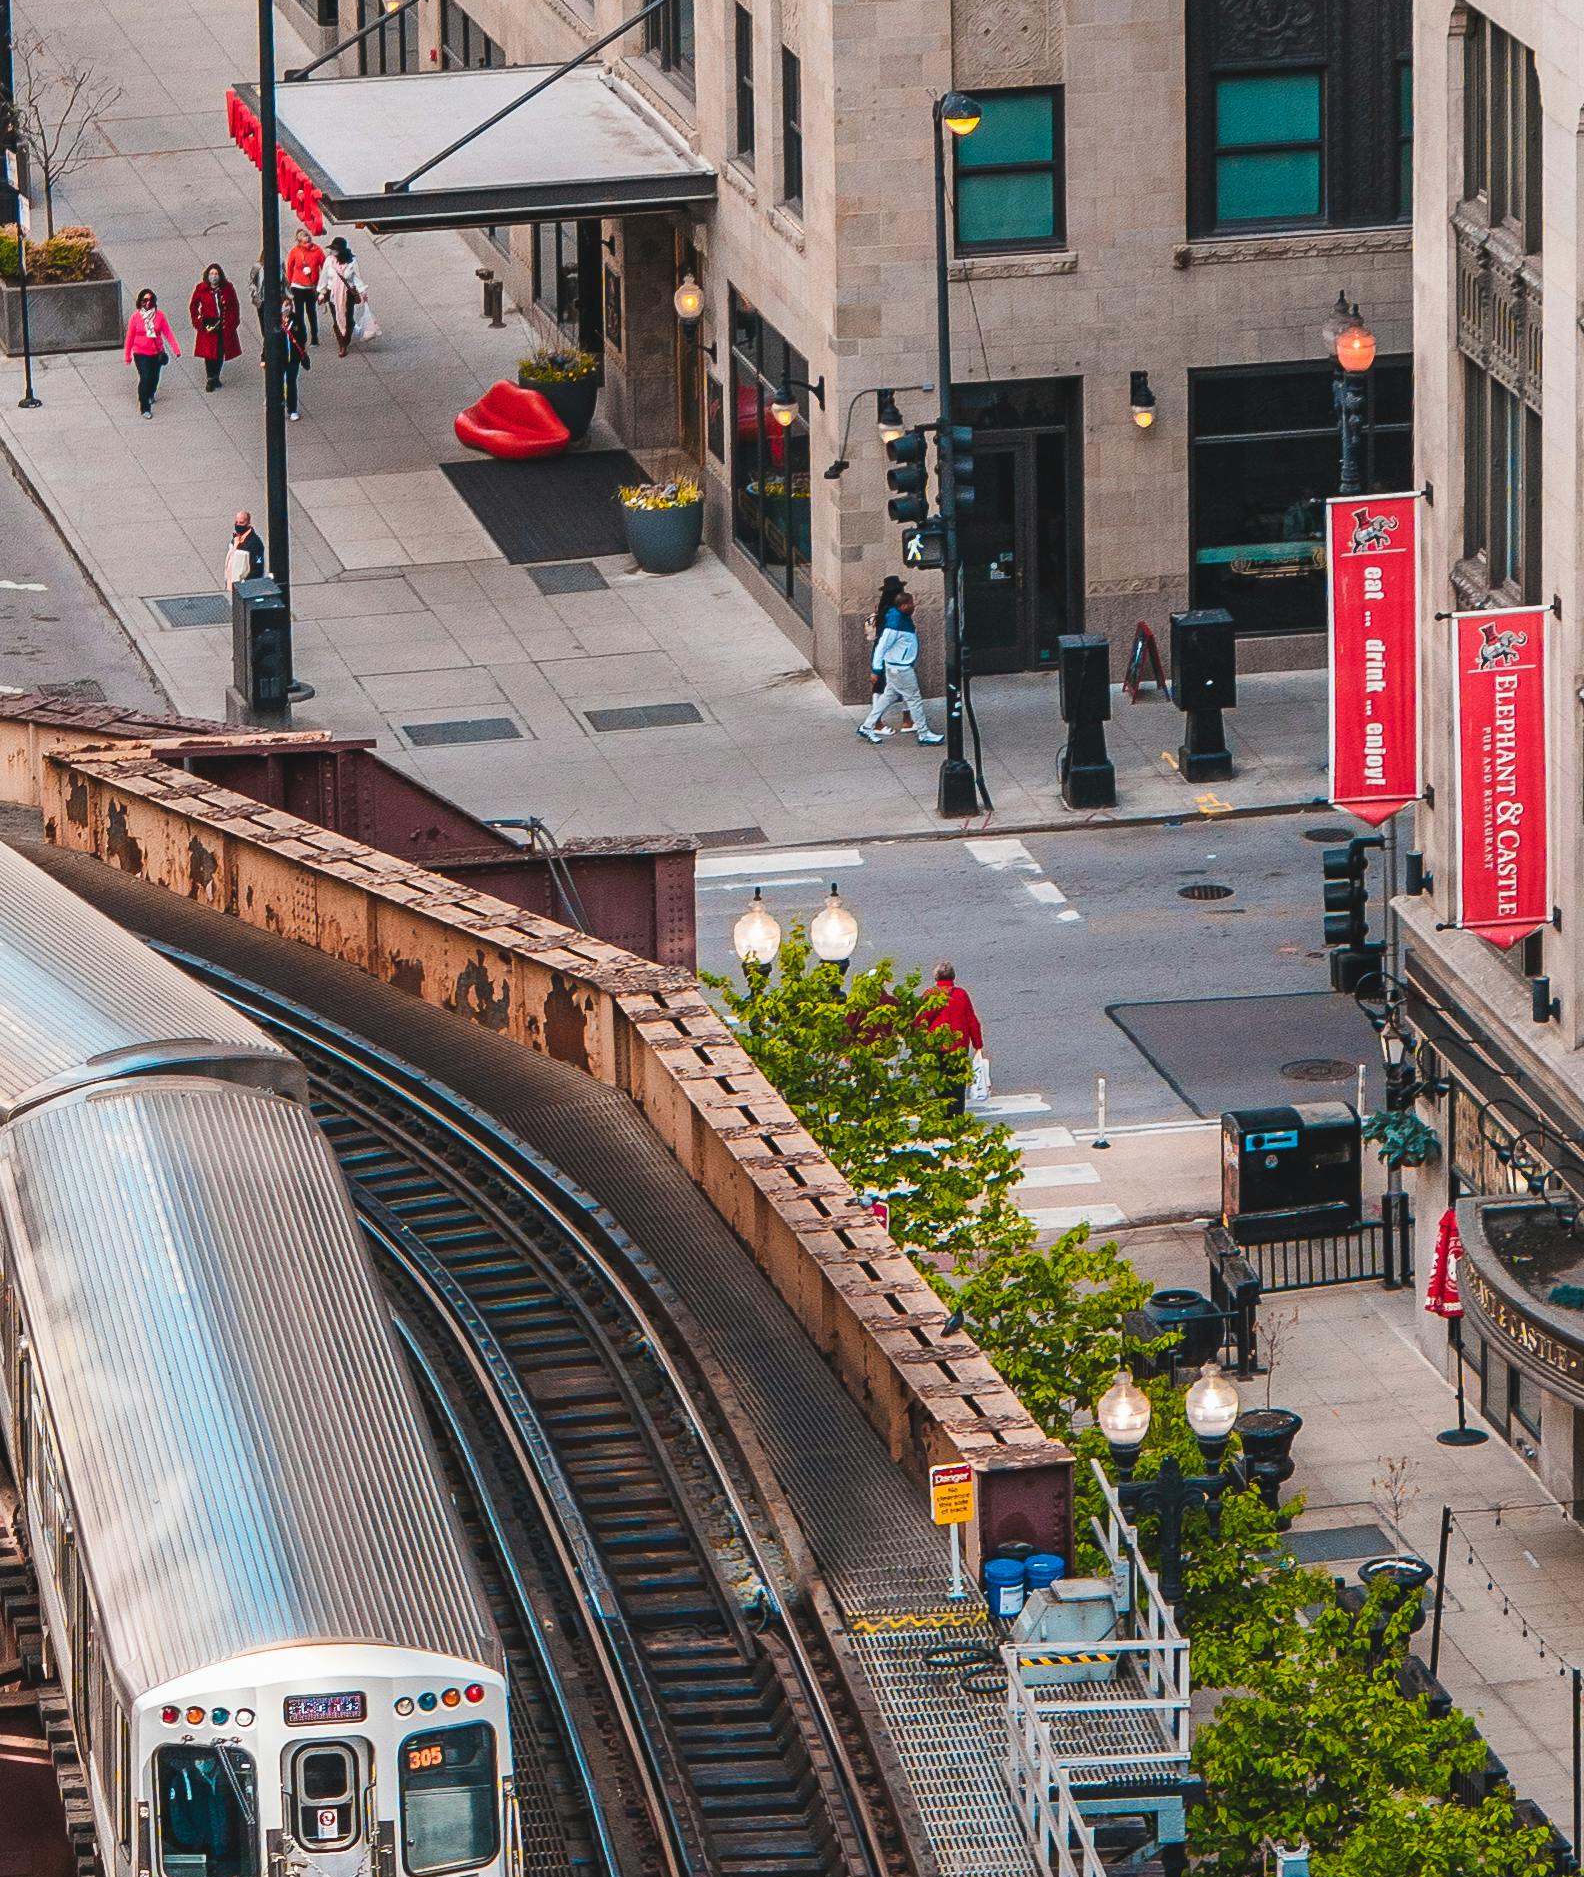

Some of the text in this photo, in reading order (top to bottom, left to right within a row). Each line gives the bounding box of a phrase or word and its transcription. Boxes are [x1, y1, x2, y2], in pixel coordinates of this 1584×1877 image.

[1364, 566, 1384, 600] eat
[1365, 639, 1386, 693] drink
[1364, 722, 1386, 785] enjoy!
[1483, 726, 1493, 871] PUB AND RESTAURANT
[1495, 674, 1524, 917] ELEPHANT & CASTLE
[934, 1473, 969, 1484] Danger
[936, 1493, 970, 1502] clearance
[408, 1746, 443, 1770] 305
